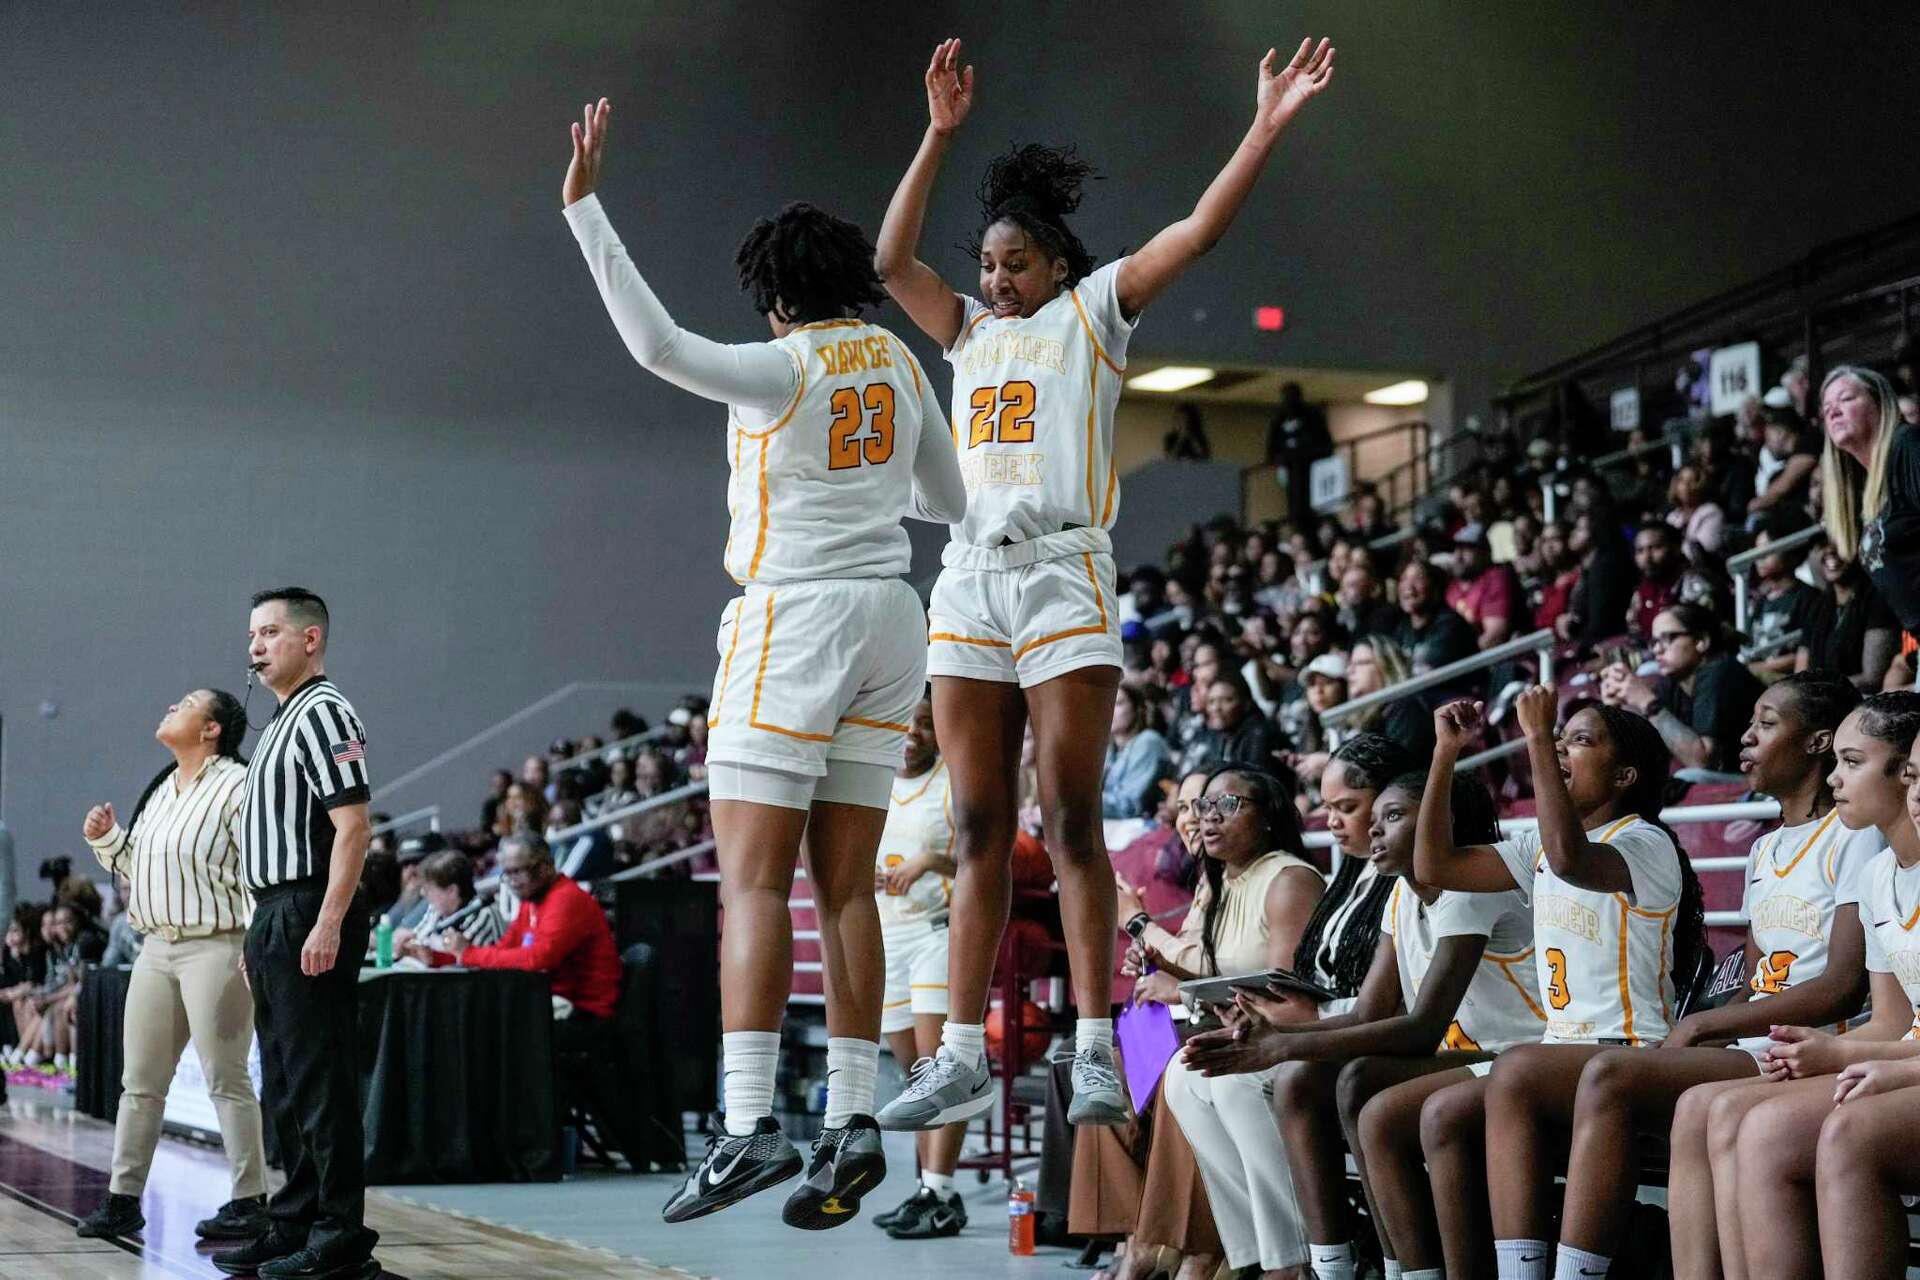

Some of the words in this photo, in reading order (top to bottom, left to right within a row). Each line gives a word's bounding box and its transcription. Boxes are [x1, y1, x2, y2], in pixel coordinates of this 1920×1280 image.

[828, 382, 895, 470] 23
[968, 380, 1036, 449] 22
[1546, 947, 1571, 1010] 3
